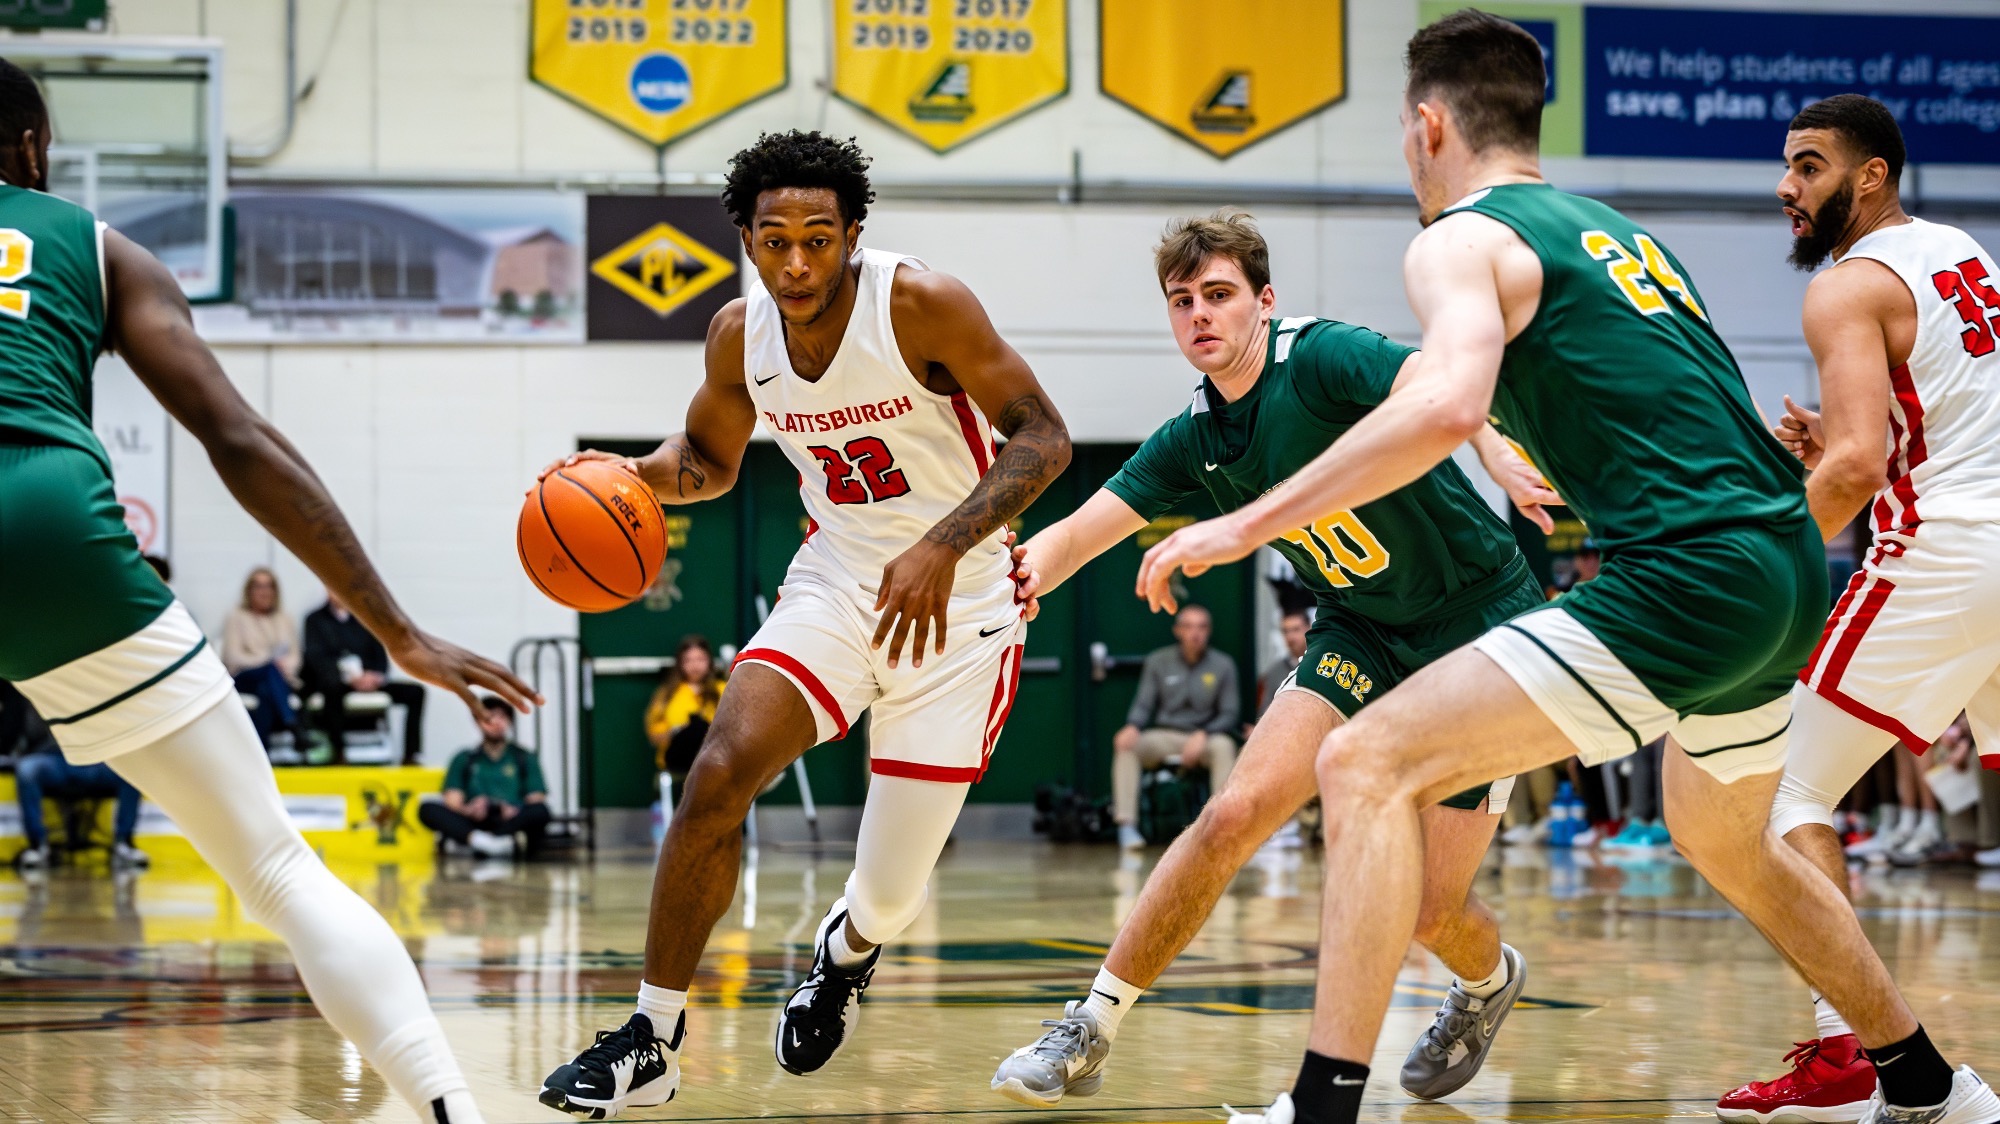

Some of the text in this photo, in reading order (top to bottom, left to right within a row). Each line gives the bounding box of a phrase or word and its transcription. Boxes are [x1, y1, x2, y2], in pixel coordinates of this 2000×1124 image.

[569, 19, 753, 42] 2019 2022
[855, 24, 1032, 50] 2019 2020
[1605, 49, 1653, 78] We
[1659, 48, 1725, 86] help
[1730, 52, 1856, 83] students
[1862, 52, 1892, 84] of
[1695, 89, 1766, 125] plan
[1772, 91, 1795, 121] &
[1580, 229, 1709, 324] 24
[1930, 256, 2000, 358] 35
[806, 435, 912, 505] 22
[610, 494, 643, 538] ROCK
[1316, 652, 1373, 704] 802
